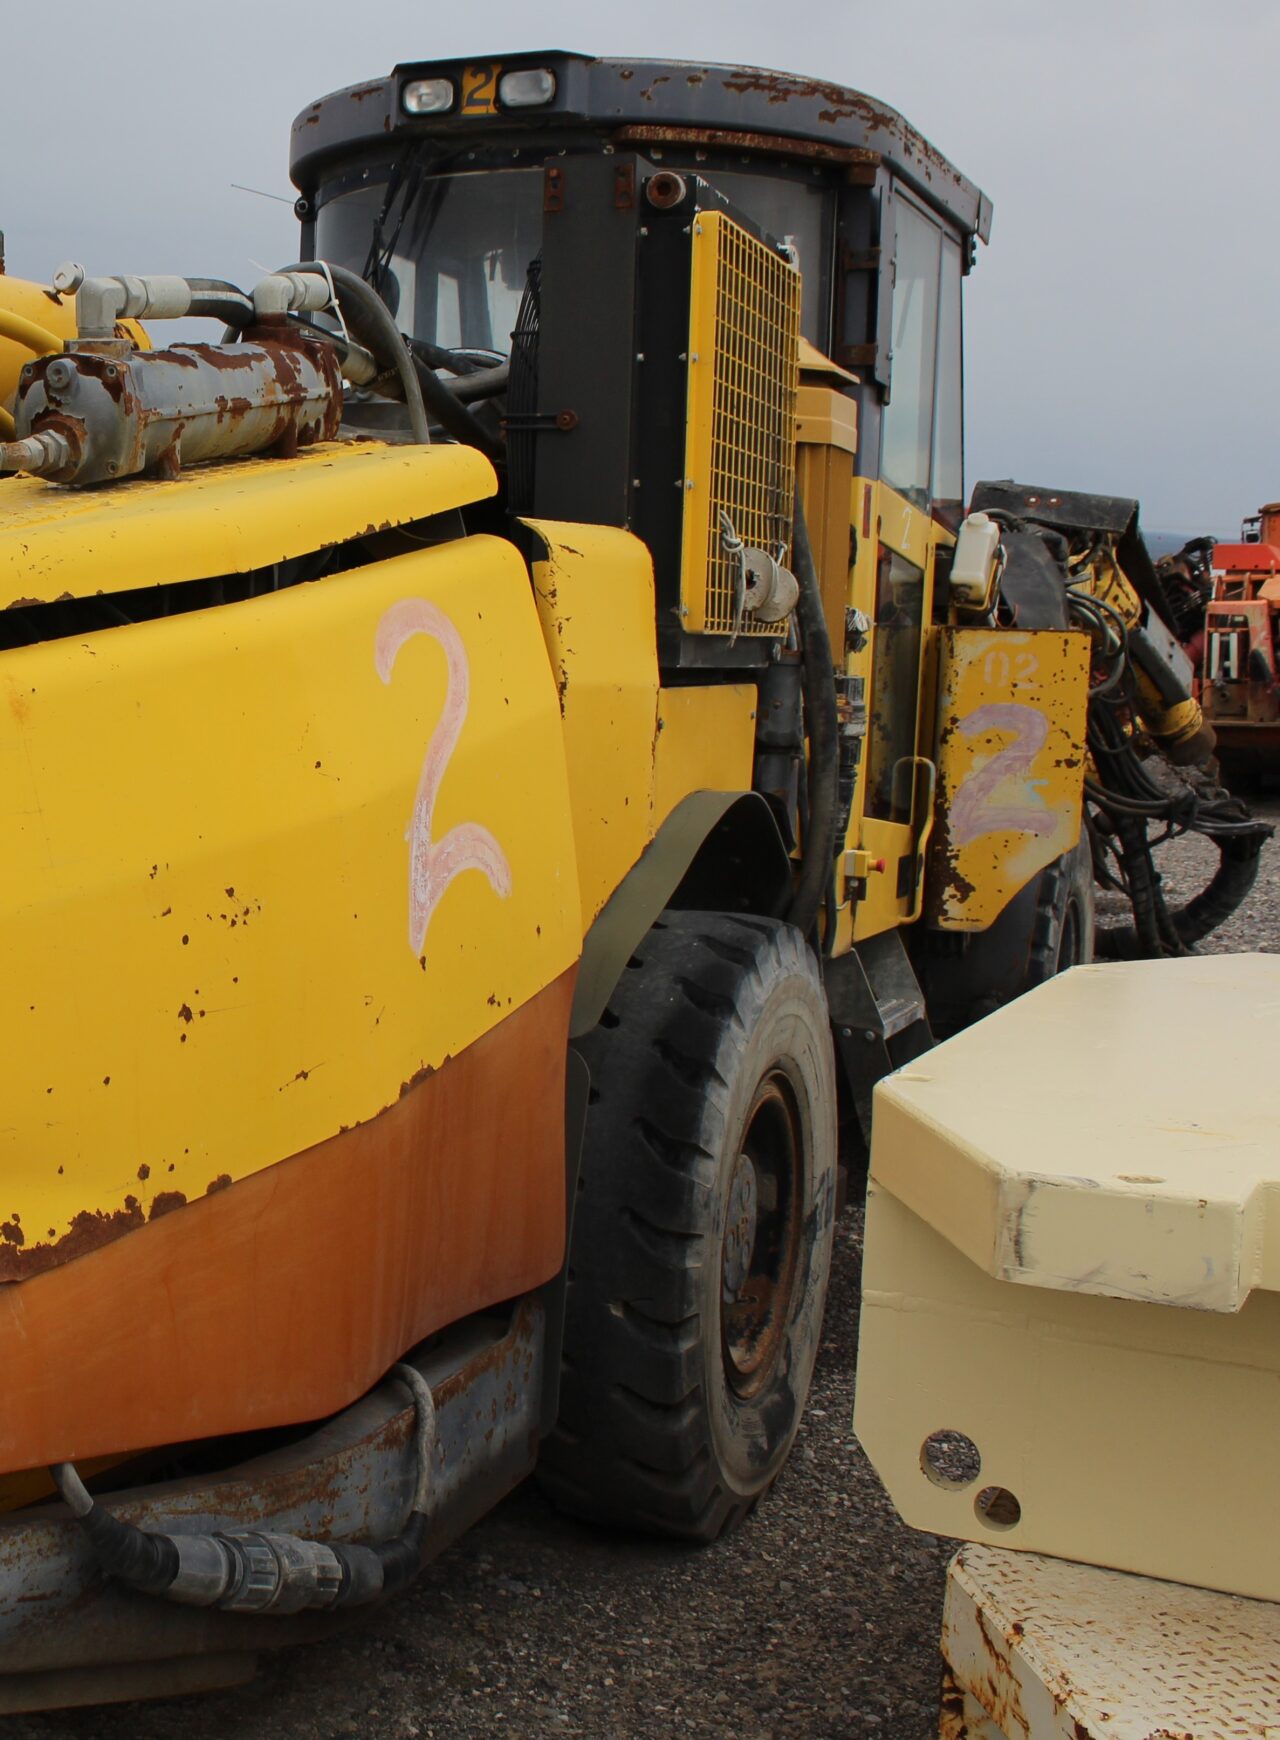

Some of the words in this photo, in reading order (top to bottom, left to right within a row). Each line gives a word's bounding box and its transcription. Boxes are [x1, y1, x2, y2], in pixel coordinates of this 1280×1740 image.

[465, 65, 494, 107] 2
[901, 506, 913, 550] 2
[983, 650, 1040, 690] 02
[374, 596, 512, 959] 2
[947, 703, 1058, 846] 2
